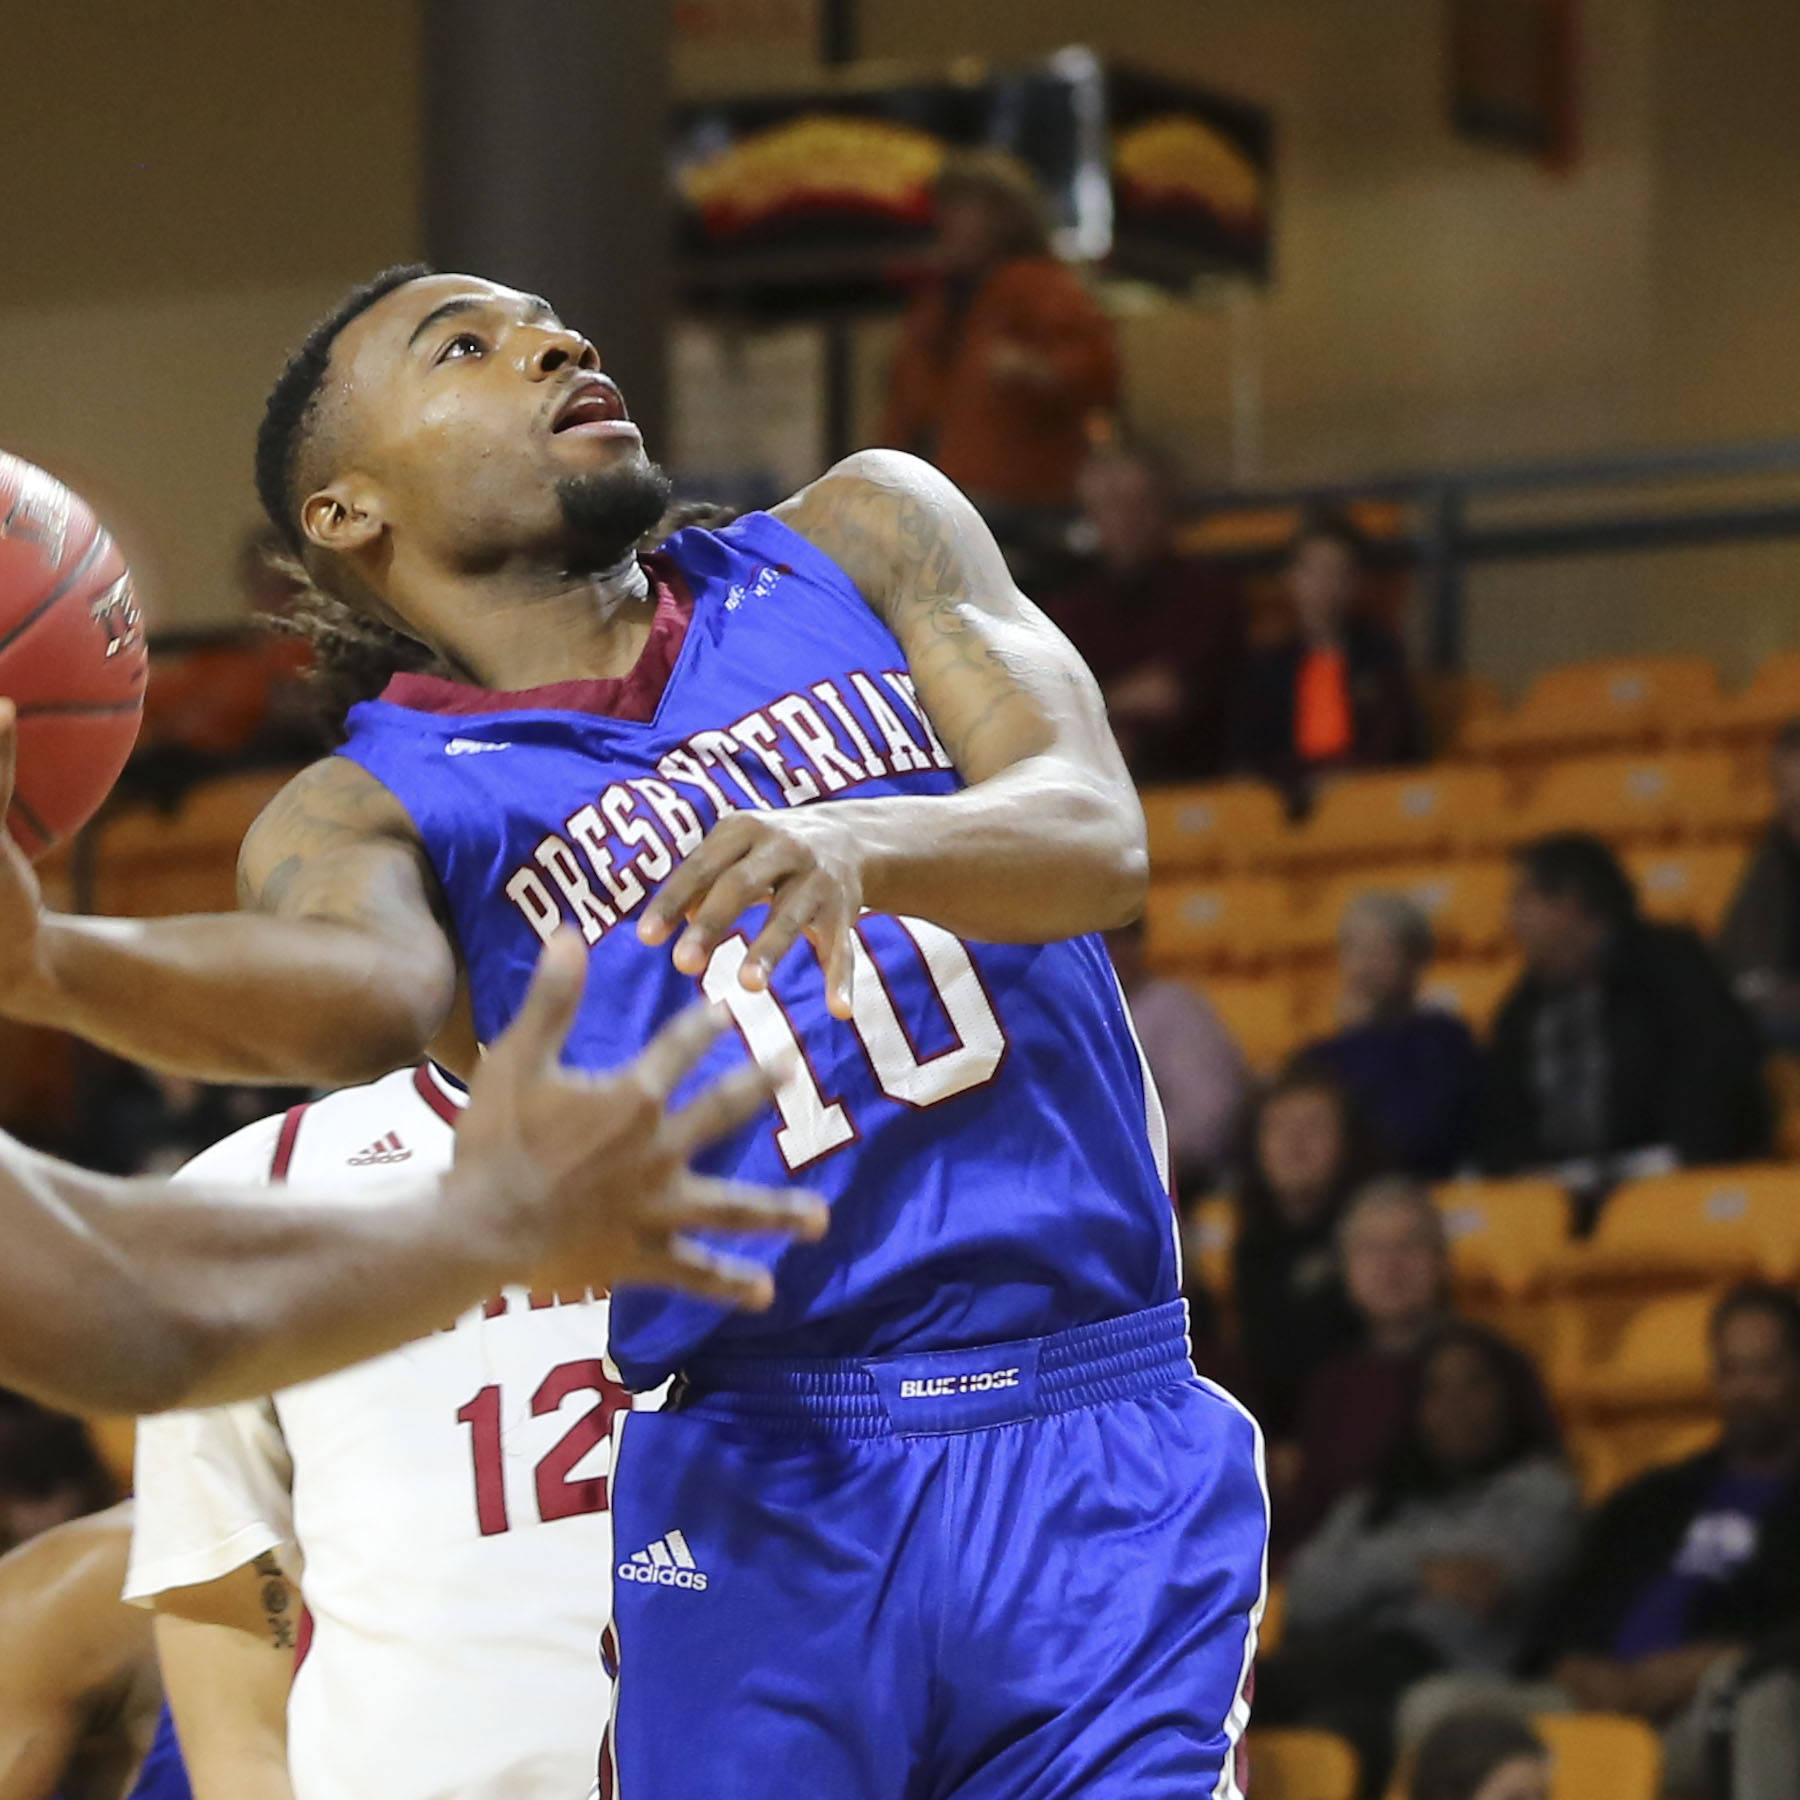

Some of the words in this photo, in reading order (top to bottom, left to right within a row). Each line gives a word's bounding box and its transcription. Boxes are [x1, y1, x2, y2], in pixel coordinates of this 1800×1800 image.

[700, 910, 1006, 1175] 10
[900, 1377, 956, 1399] BLUE
[456, 1357, 634, 1537] 12
[617, 1562, 709, 1592] adidas
